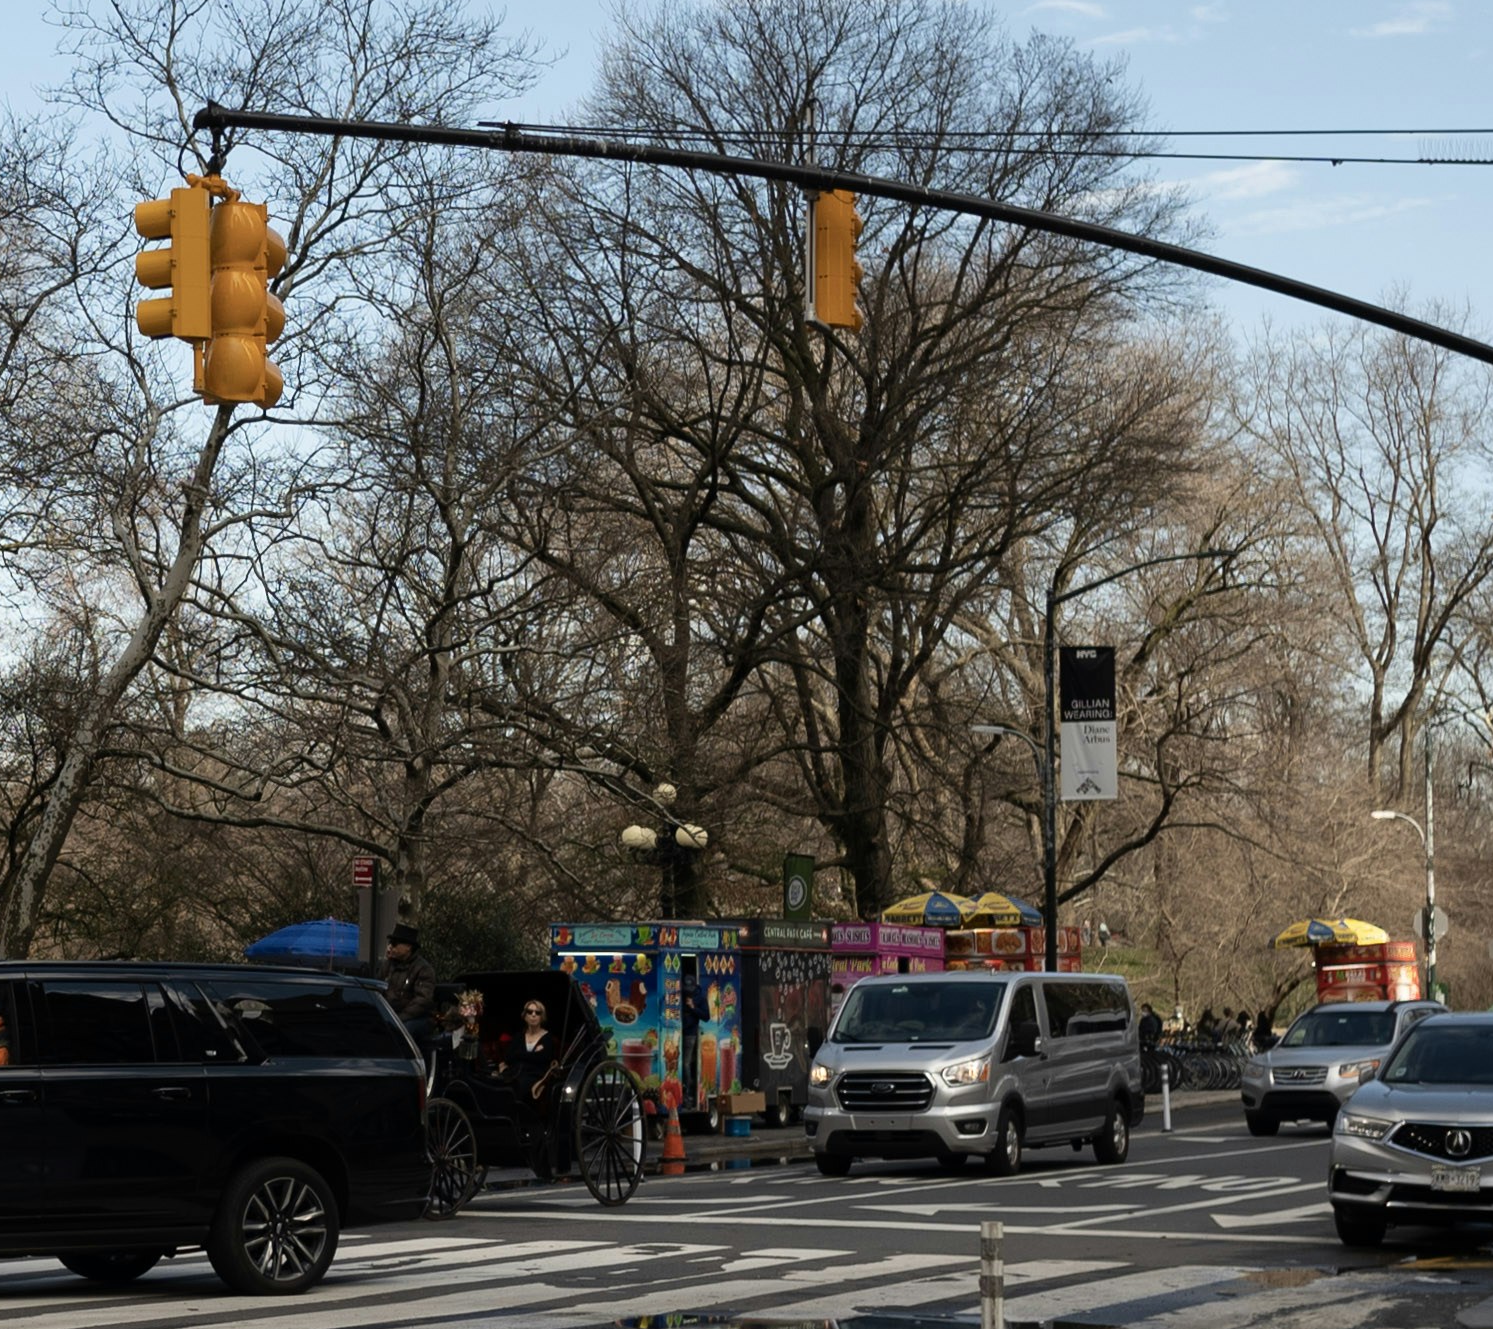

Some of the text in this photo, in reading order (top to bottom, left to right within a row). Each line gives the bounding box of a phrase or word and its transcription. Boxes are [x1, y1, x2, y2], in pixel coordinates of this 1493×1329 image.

[1071, 698, 1110, 709] GILLIAN
[1084, 725, 1110, 734] Diane
[1083, 735, 1110, 744] Arbus
[764, 927, 786, 939] CENTRAL
[787, 928, 799, 939] PARK
[850, 955, 872, 971] Park
